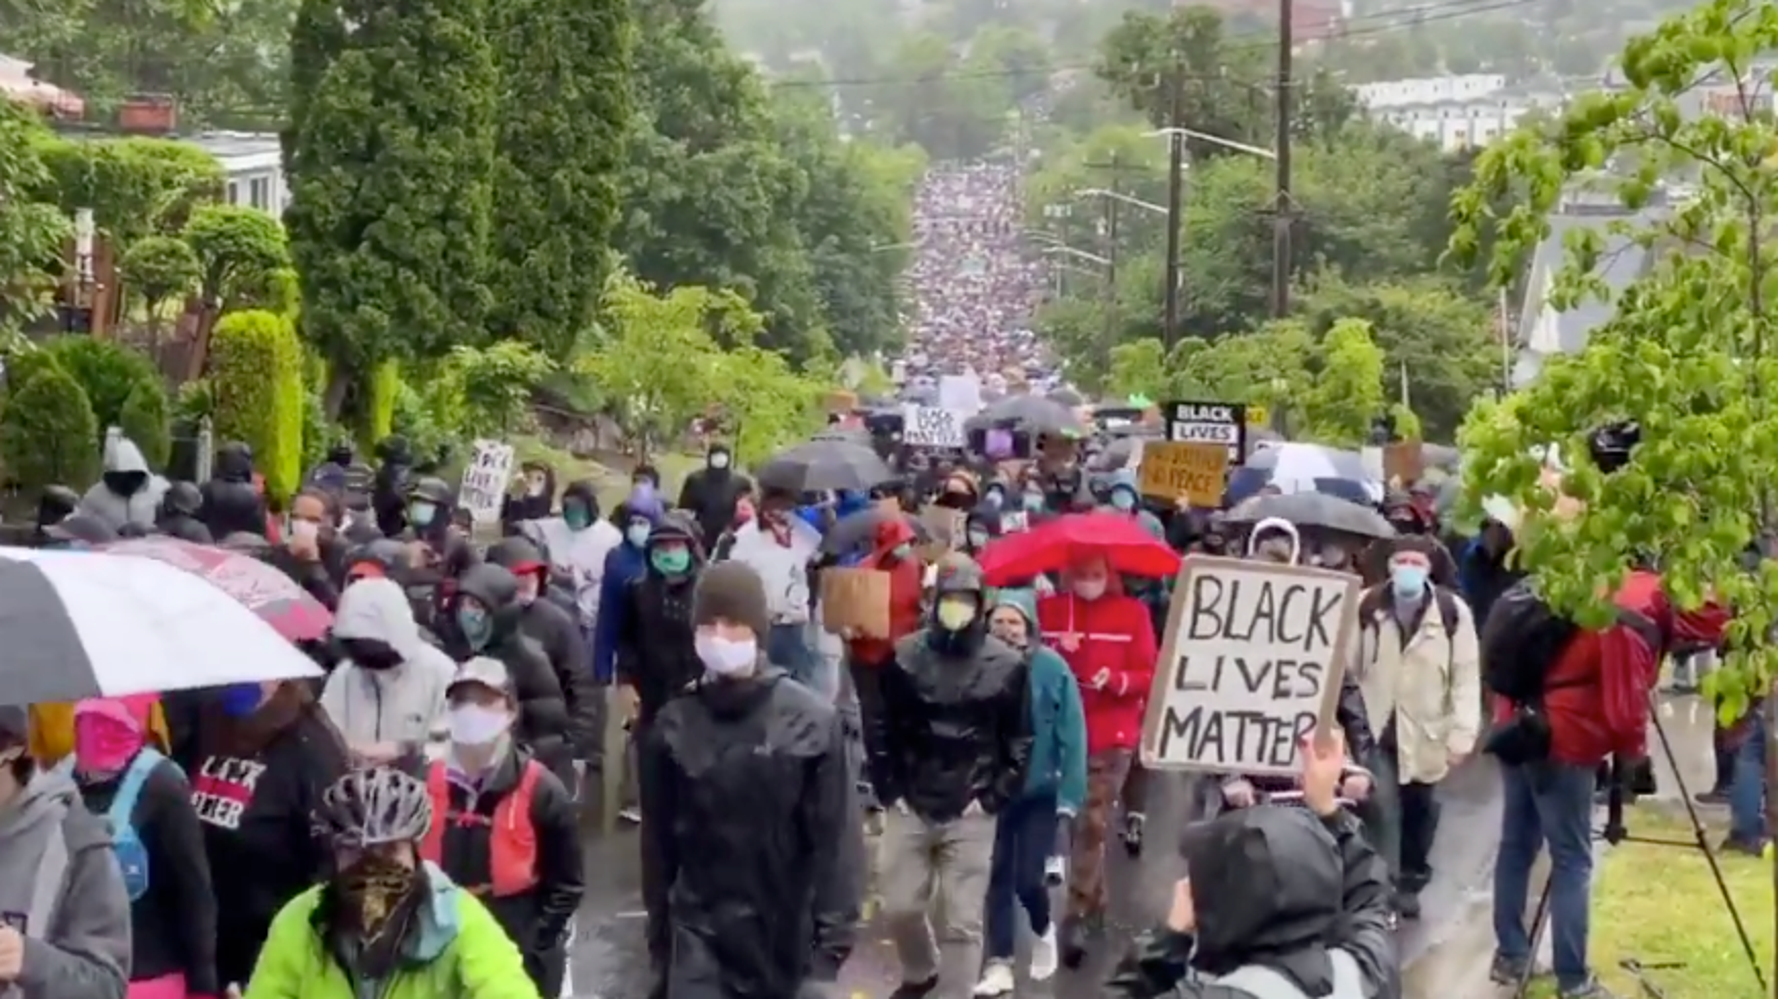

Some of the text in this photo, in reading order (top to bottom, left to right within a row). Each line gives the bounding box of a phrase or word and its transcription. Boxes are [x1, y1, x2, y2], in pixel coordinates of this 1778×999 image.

[1176, 404, 1233, 421] BLACK
[1179, 426, 1231, 439] LIVES
[1168, 467, 1212, 493] PEACE
[1188, 575, 1342, 652] BLACK
[1175, 655, 1323, 700] LIVES
[1159, 705, 1318, 766] MATTER
